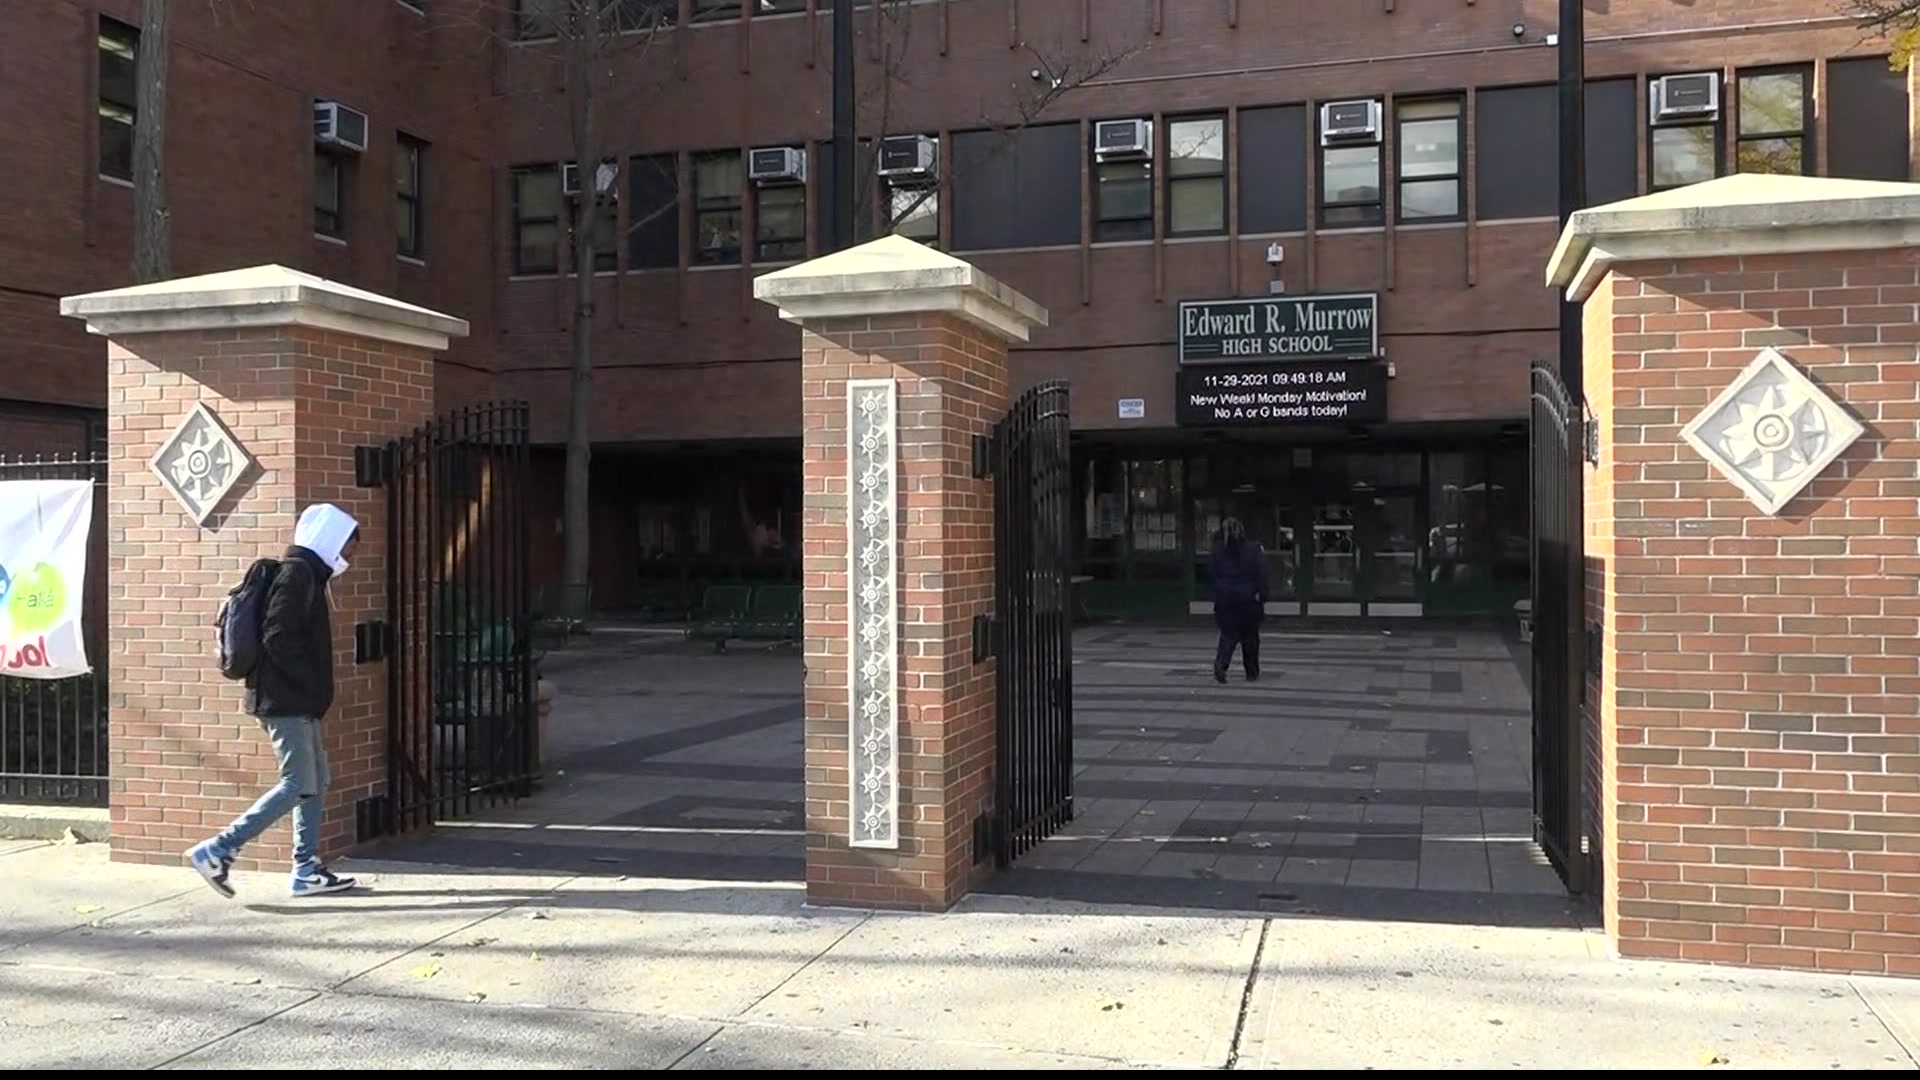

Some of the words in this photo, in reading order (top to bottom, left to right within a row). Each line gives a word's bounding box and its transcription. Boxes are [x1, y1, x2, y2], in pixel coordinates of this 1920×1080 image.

[1184, 304, 1256, 337] Edward
[1265, 304, 1286, 334] R.
[1294, 302, 1373, 333] Murrow
[1222, 338, 1263, 355] HIGH
[1268, 335, 1334, 354] SCHOOL
[1204, 374, 1268, 387] 11-29-2021
[1325, 371, 1347, 384] AM
[1190, 394, 1217, 406] New
[1257, 391, 1303, 405] Monday
[1305, 389, 1367, 402] Motivation!
[1214, 407, 1231, 419] No
[1233, 407, 1244, 418] A
[1246, 408, 1258, 418] or
[1260, 406, 1270, 418] G
[1272, 405, 1309, 418] bands
[1311, 404, 1348, 417] today!
